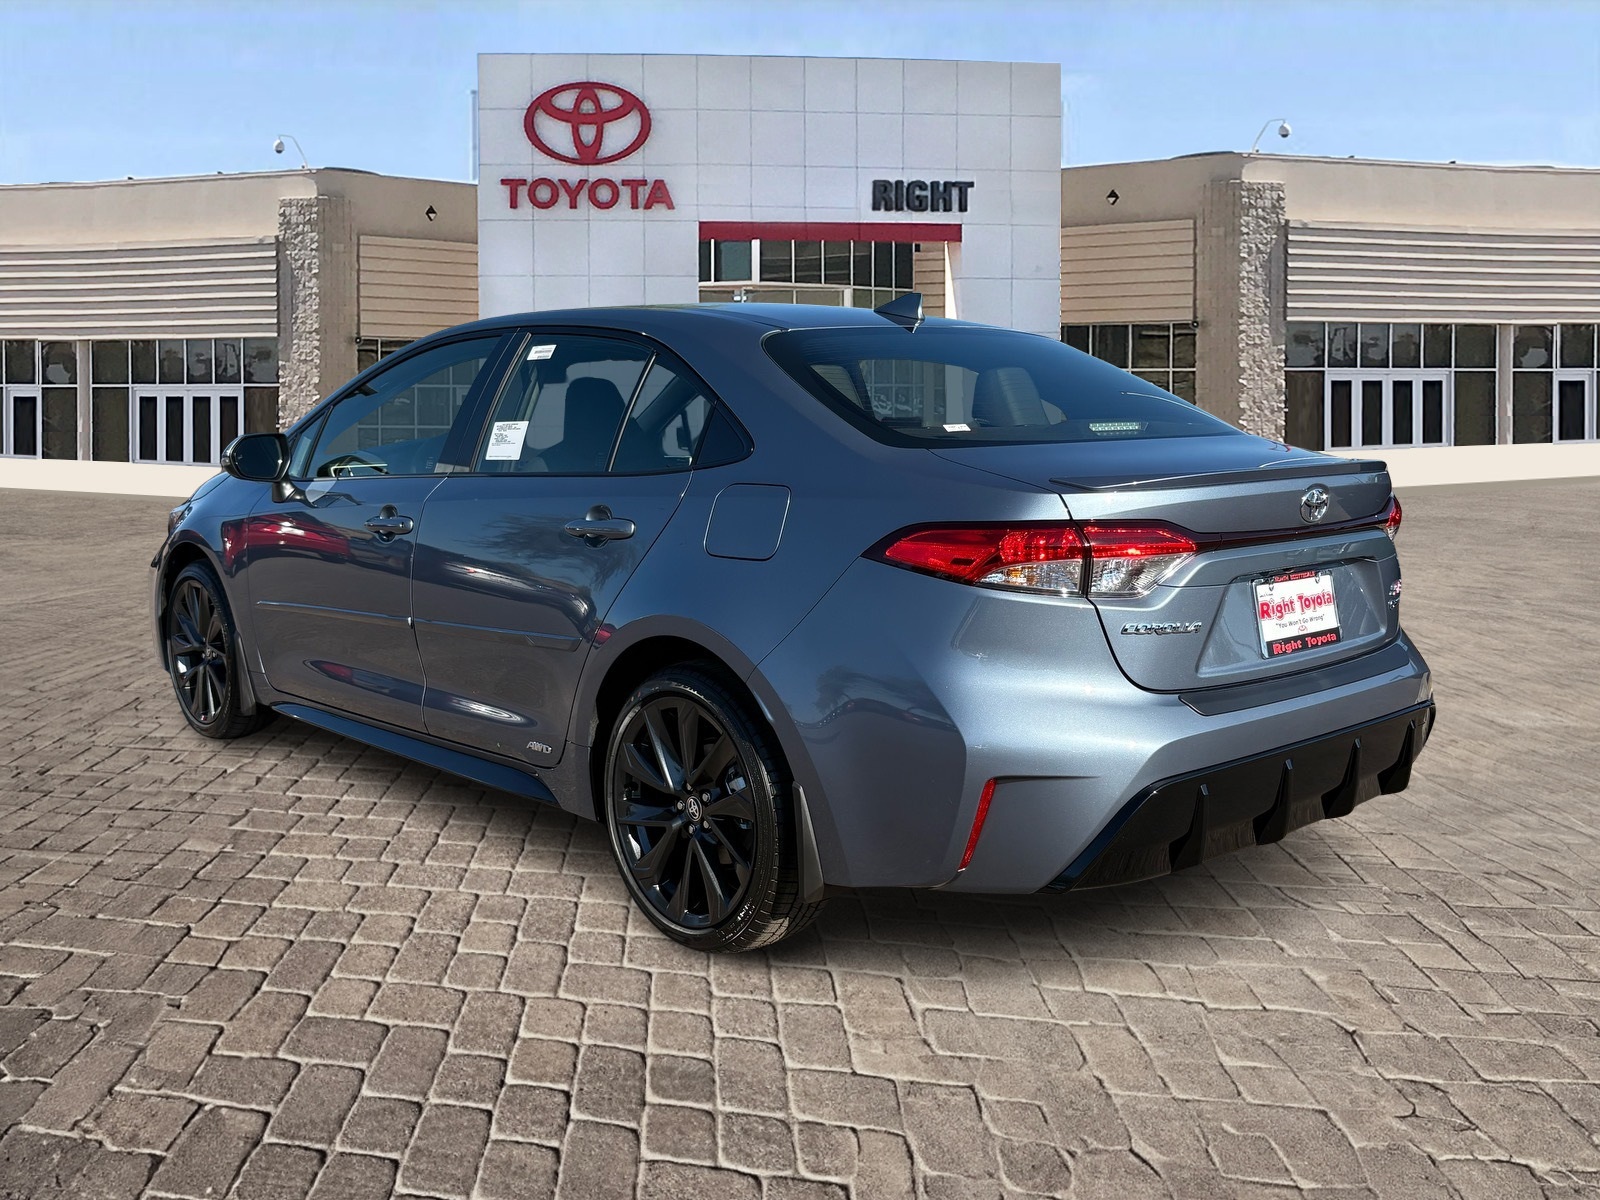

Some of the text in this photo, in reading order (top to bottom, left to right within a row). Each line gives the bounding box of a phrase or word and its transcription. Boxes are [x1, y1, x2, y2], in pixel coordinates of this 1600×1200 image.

[500, 179, 675, 210] TOYOTA
[872, 179, 975, 212] RIGHT
[1259, 592, 1333, 620] Right Toyota
[1121, 621, 1202, 635] COROLLA
[1289, 618, 1302, 626] Won't
[1273, 633, 1337, 654] Right Toyota
[526, 741, 552, 754] AWD
